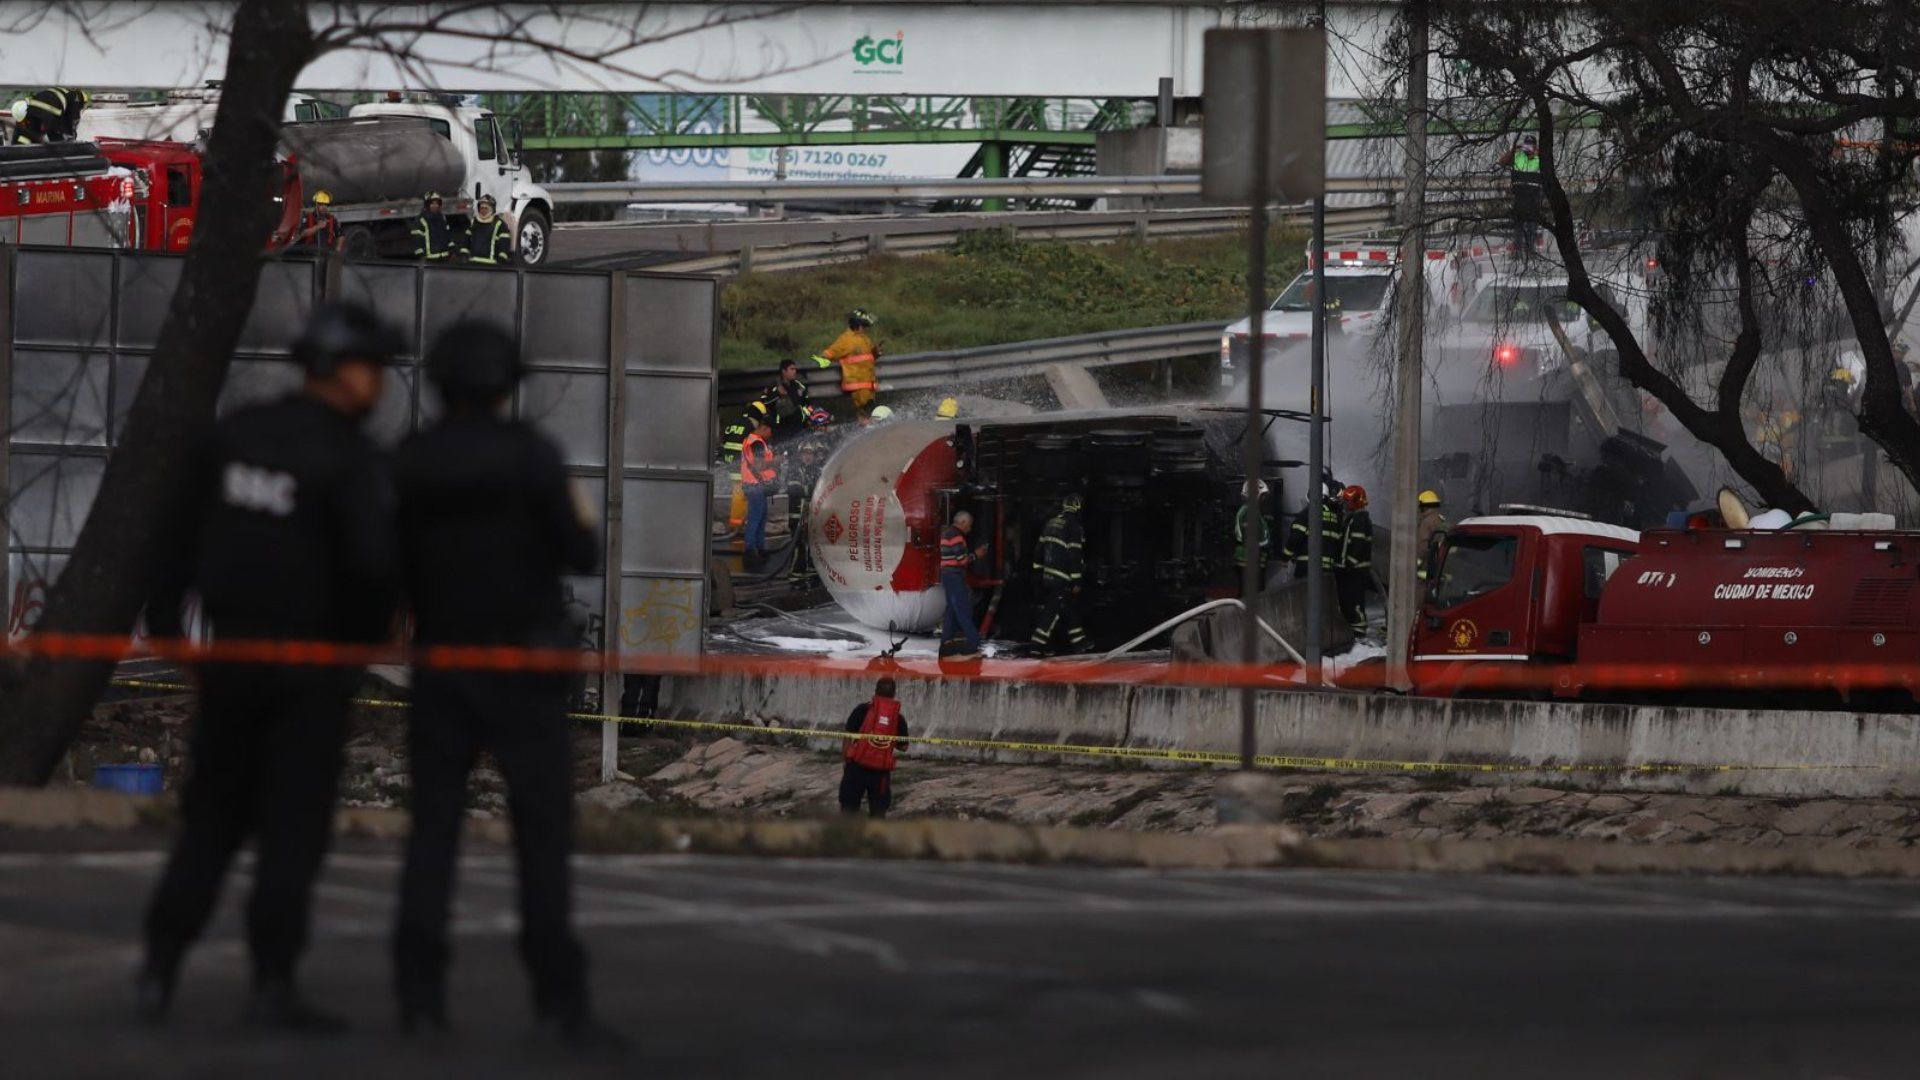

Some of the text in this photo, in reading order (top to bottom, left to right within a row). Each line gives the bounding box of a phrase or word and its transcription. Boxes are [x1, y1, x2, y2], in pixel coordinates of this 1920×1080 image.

[803, 150, 843, 166] 7120
[847, 152, 887, 168] 0267
[849, 500, 861, 562] PELIGROSO
[1714, 583, 1815, 600] CIUDAD DE MEXICO
